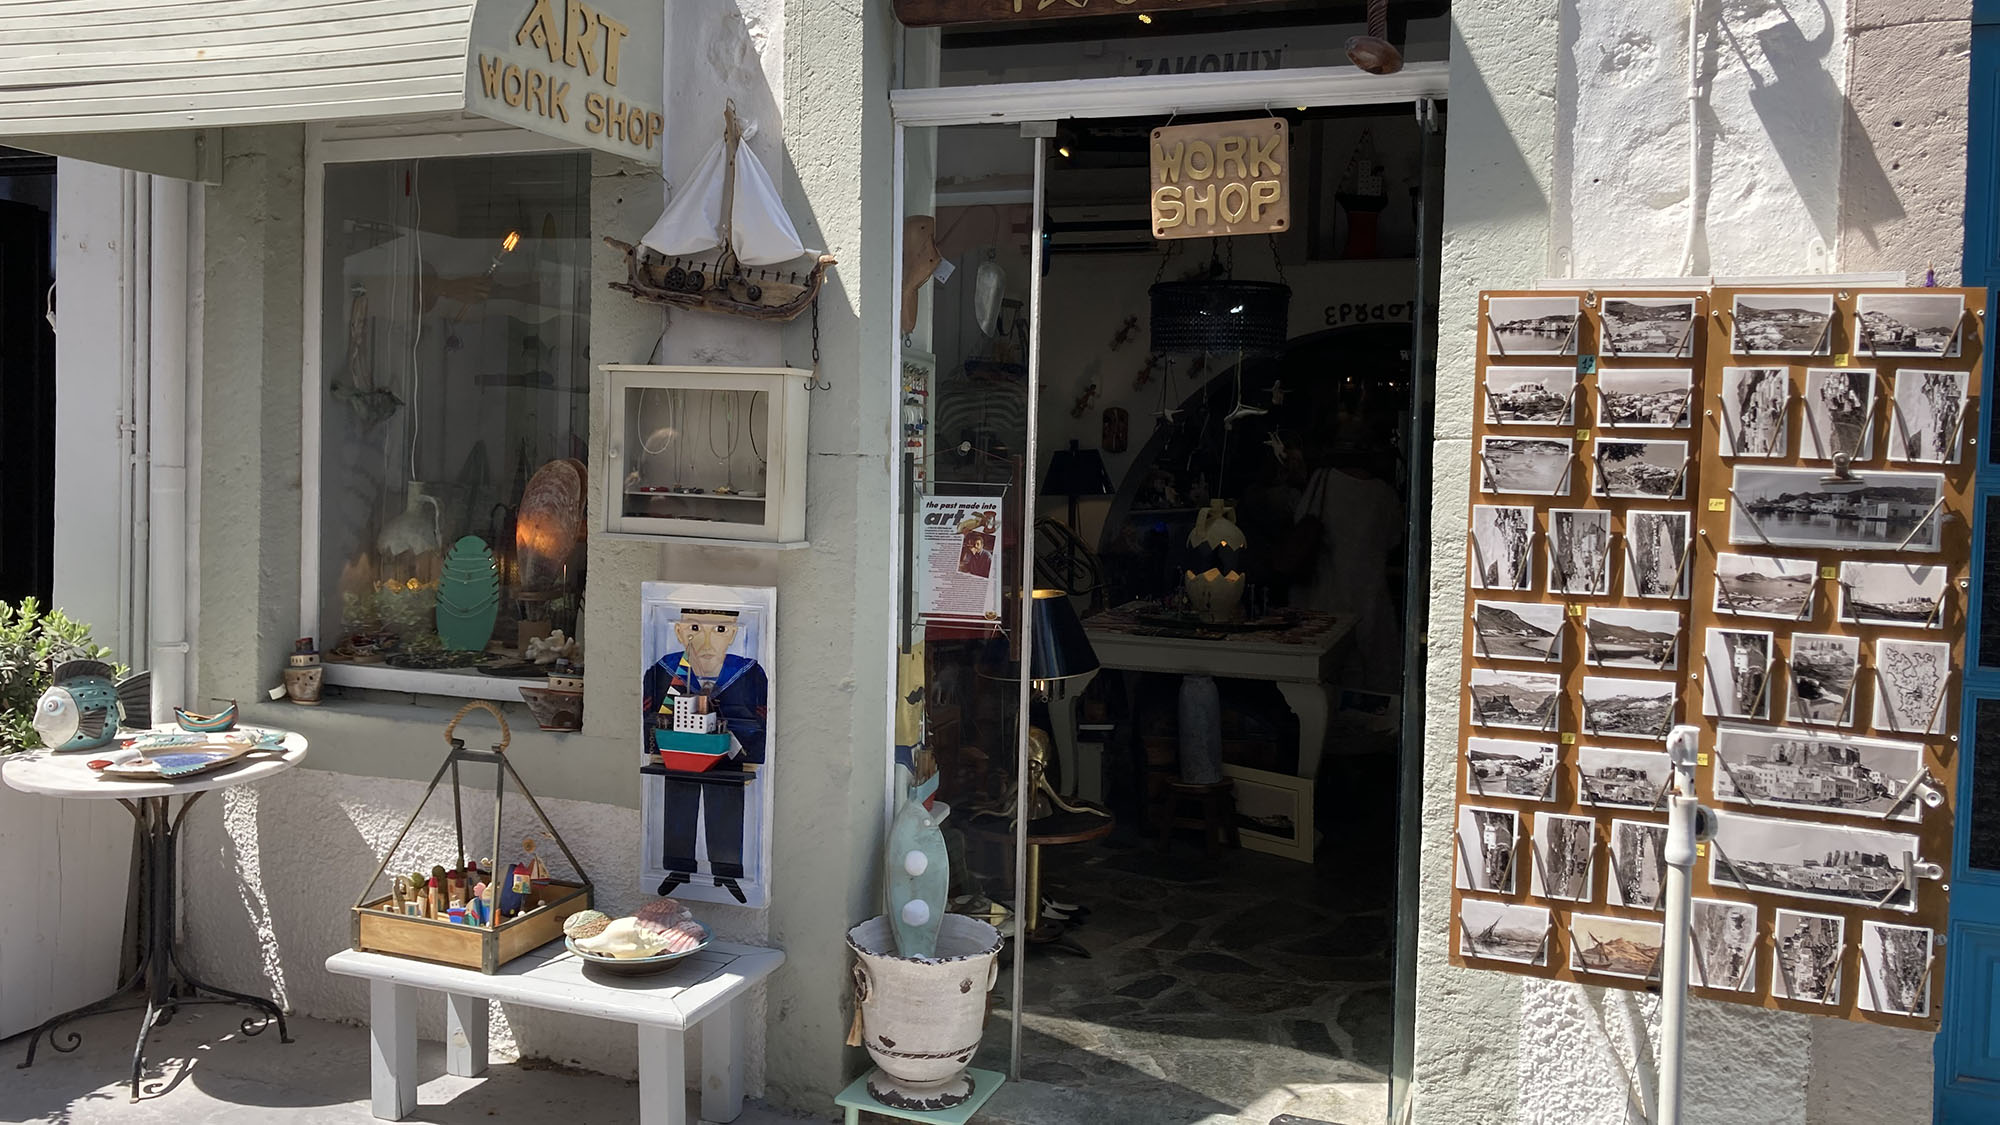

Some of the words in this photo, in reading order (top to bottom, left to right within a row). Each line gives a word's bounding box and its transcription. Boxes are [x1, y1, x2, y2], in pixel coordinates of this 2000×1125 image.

[516, 0, 630, 87] ART
[479, 53, 570, 123] WORK
[585, 92, 664, 149] SHOP
[1153, 134, 1281, 184] WORK
[1153, 180, 1281, 228] SHOP
[924, 510, 965, 525] art
[939, 502, 957, 510] past
